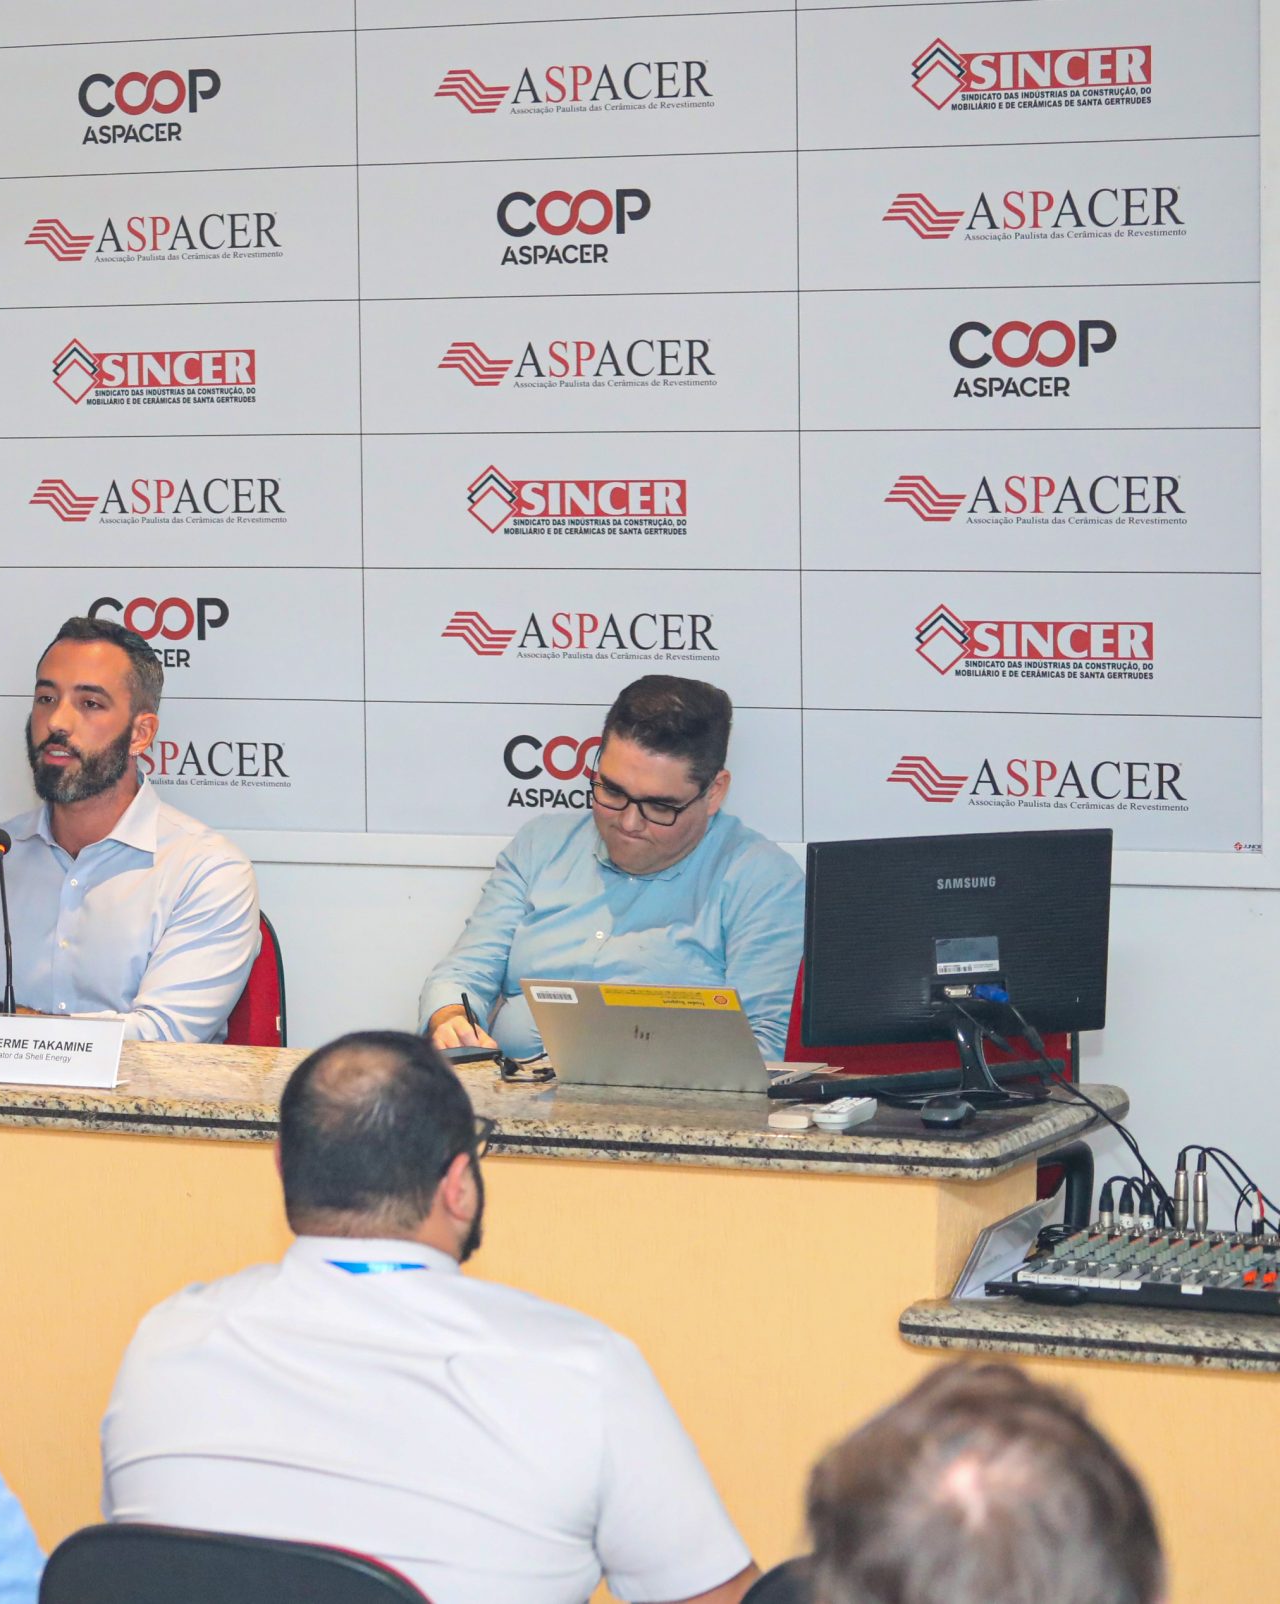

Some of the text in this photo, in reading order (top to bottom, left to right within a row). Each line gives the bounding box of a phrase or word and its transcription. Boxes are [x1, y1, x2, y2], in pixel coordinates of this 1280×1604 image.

[511, 61, 712, 104] ASPACER
[969, 47, 1148, 89] SINCER
[78, 69, 221, 117] COOP
[951, 101, 996, 110] MOBILIÁRIO
[1018, 100, 1062, 108] CERÂMICAS
[1077, 98, 1102, 106] SANTA
[1105, 97, 1151, 105] GERTRUDES
[961, 93, 1001, 101] SINDICATO
[1022, 90, 1068, 99] INDÚSTRIAS
[1070, 89, 1080, 97] DA
[1082, 87, 1138, 96] CONSTRUÇÃO,
[82, 123, 182, 145] ASPACER
[497, 189, 651, 237] COOP
[965, 187, 1184, 229] ASPACER
[94, 213, 280, 253] ASPACER
[964, 233, 1011, 242] Associação
[1127, 229, 1187, 237] Revestimento
[233, 251, 283, 259] Revestimento
[500, 244, 608, 266] ASPACER
[514, 340, 716, 376] ASPACER
[950, 320, 1116, 368] COOP
[102, 350, 251, 385] SINCER
[953, 377, 1070, 397] ASPACER
[101, 479, 284, 514] ASPACER
[519, 481, 683, 516] SINCER
[967, 476, 1186, 514] ASPACER
[99, 517, 139, 525] Associação
[967, 517, 1013, 525] Associação
[518, 615, 718, 651] ASPACER
[972, 623, 1149, 659] SINCER
[955, 669, 999, 677] MOBILIÁRIO
[1021, 670, 1065, 678] CERÂMICAS
[1025, 661, 1070, 669] INDÚSTRIAS
[1085, 662, 1140, 671] CONSTRUÇÃO,
[138, 741, 289, 778] SPACER
[504, 735, 602, 781] COO
[969, 758, 1187, 800] ASPACER
[507, 788, 592, 809] ASPACE
[937, 876, 996, 890] SAMSUNG
[25, 1052, 43, 1061] Shell
[45, 1054, 72, 1063] Energy
[33, 1040, 93, 1053] TAKAMINE
